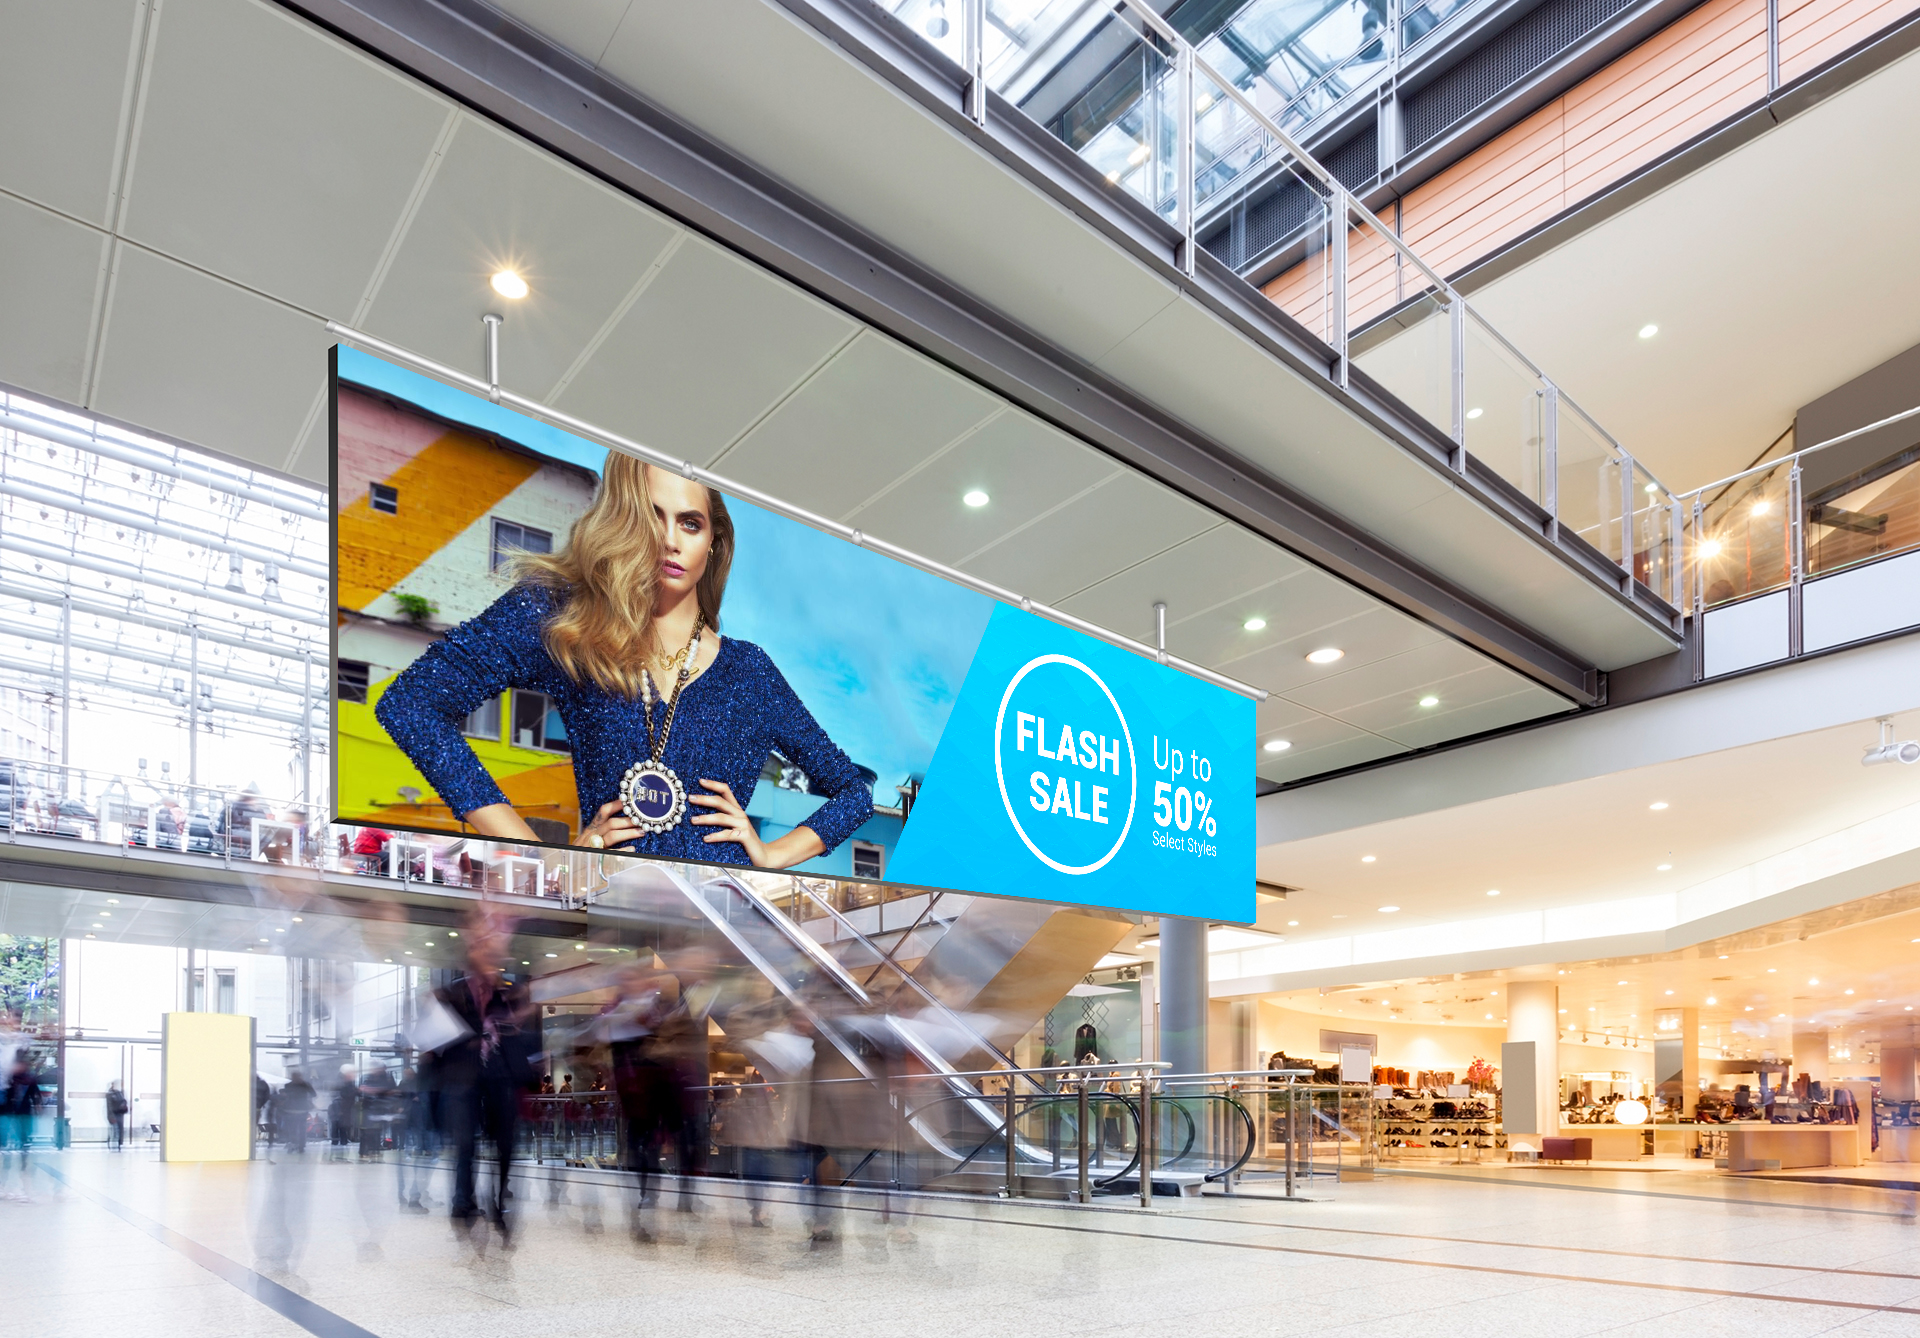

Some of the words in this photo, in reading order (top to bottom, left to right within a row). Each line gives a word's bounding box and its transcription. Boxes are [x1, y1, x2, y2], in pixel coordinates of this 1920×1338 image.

[1016, 710, 1120, 776] FLASH
[1153, 734, 1184, 782] Up
[1190, 749, 1212, 783] to
[1029, 770, 1109, 825] SALE
[1153, 780, 1217, 838] 50%
[1152, 830, 1185, 852] Select
[1187, 837, 1217, 858] Styles
